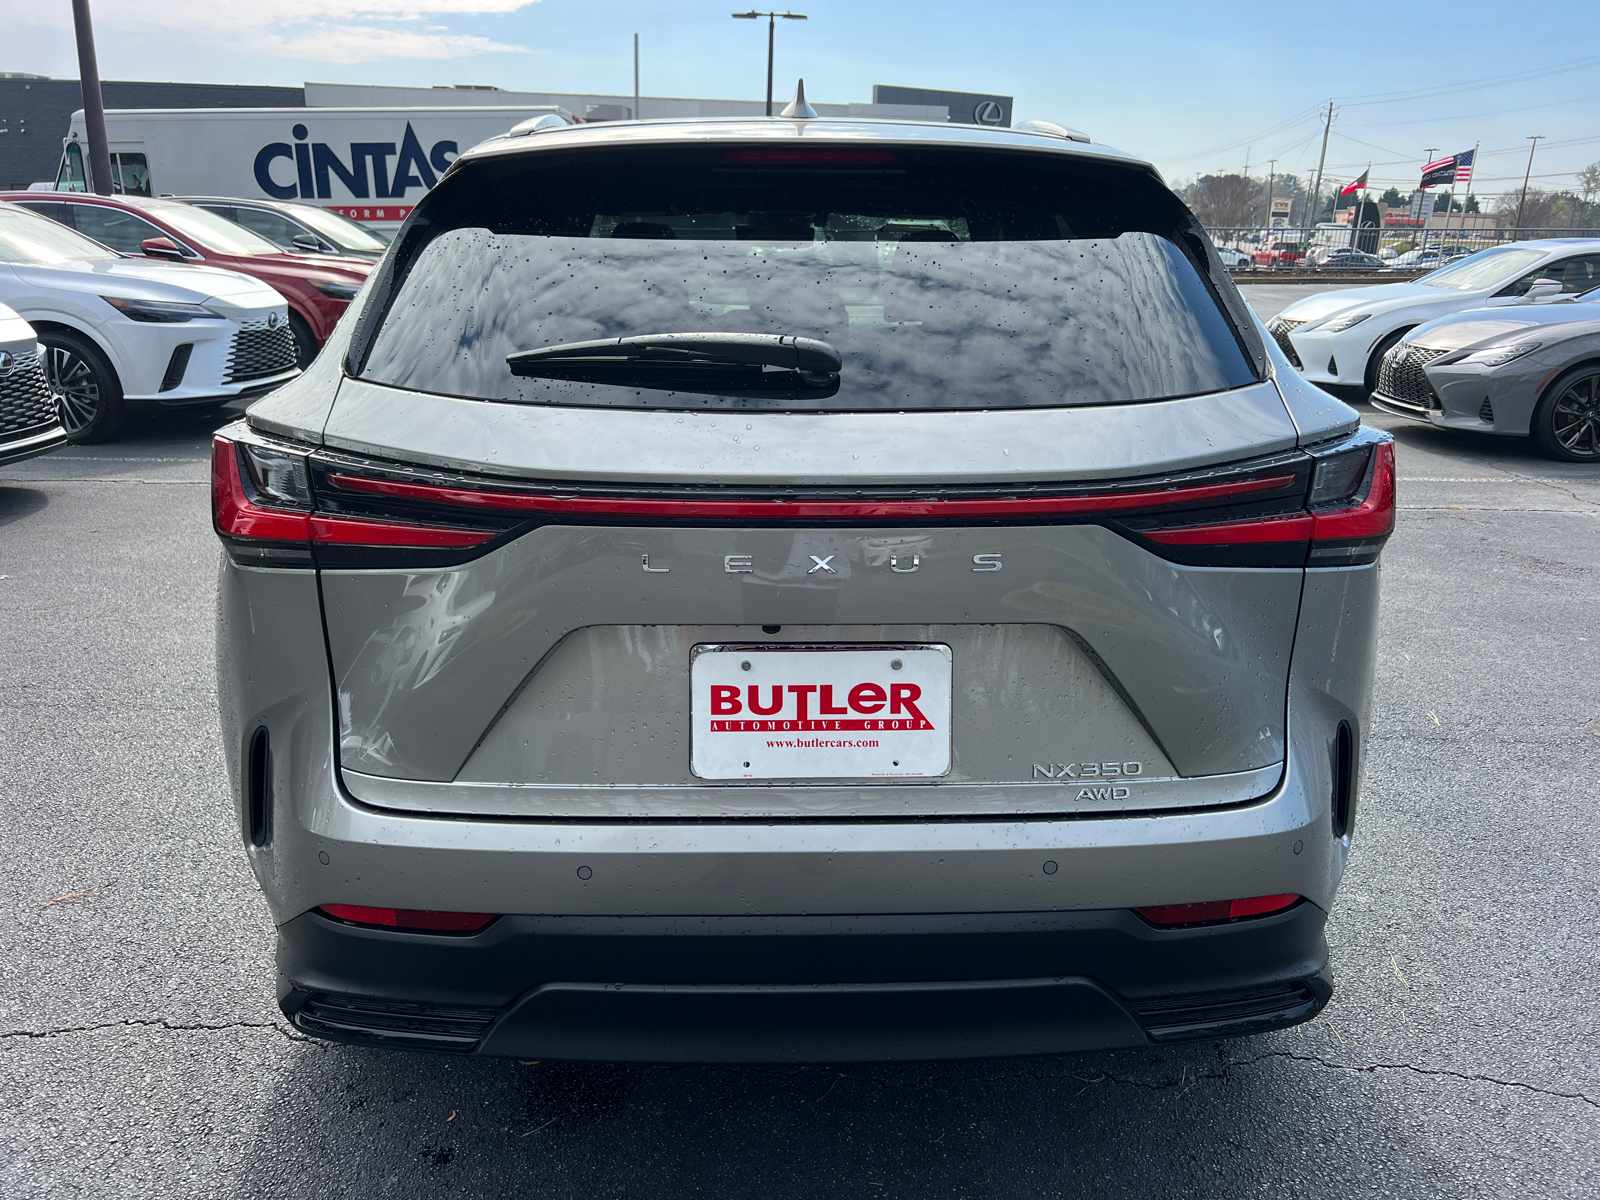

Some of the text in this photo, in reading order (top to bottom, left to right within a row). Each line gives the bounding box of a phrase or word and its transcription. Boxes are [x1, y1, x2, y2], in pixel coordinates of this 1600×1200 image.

[641, 551, 1003, 574] LEXUS
[711, 719, 926, 731] AUTOMOTIVE GROUP
[766, 738, 879, 748] www.butlercars.com
[1033, 761, 1143, 779] NX350
[1075, 786, 1130, 801] AWD
